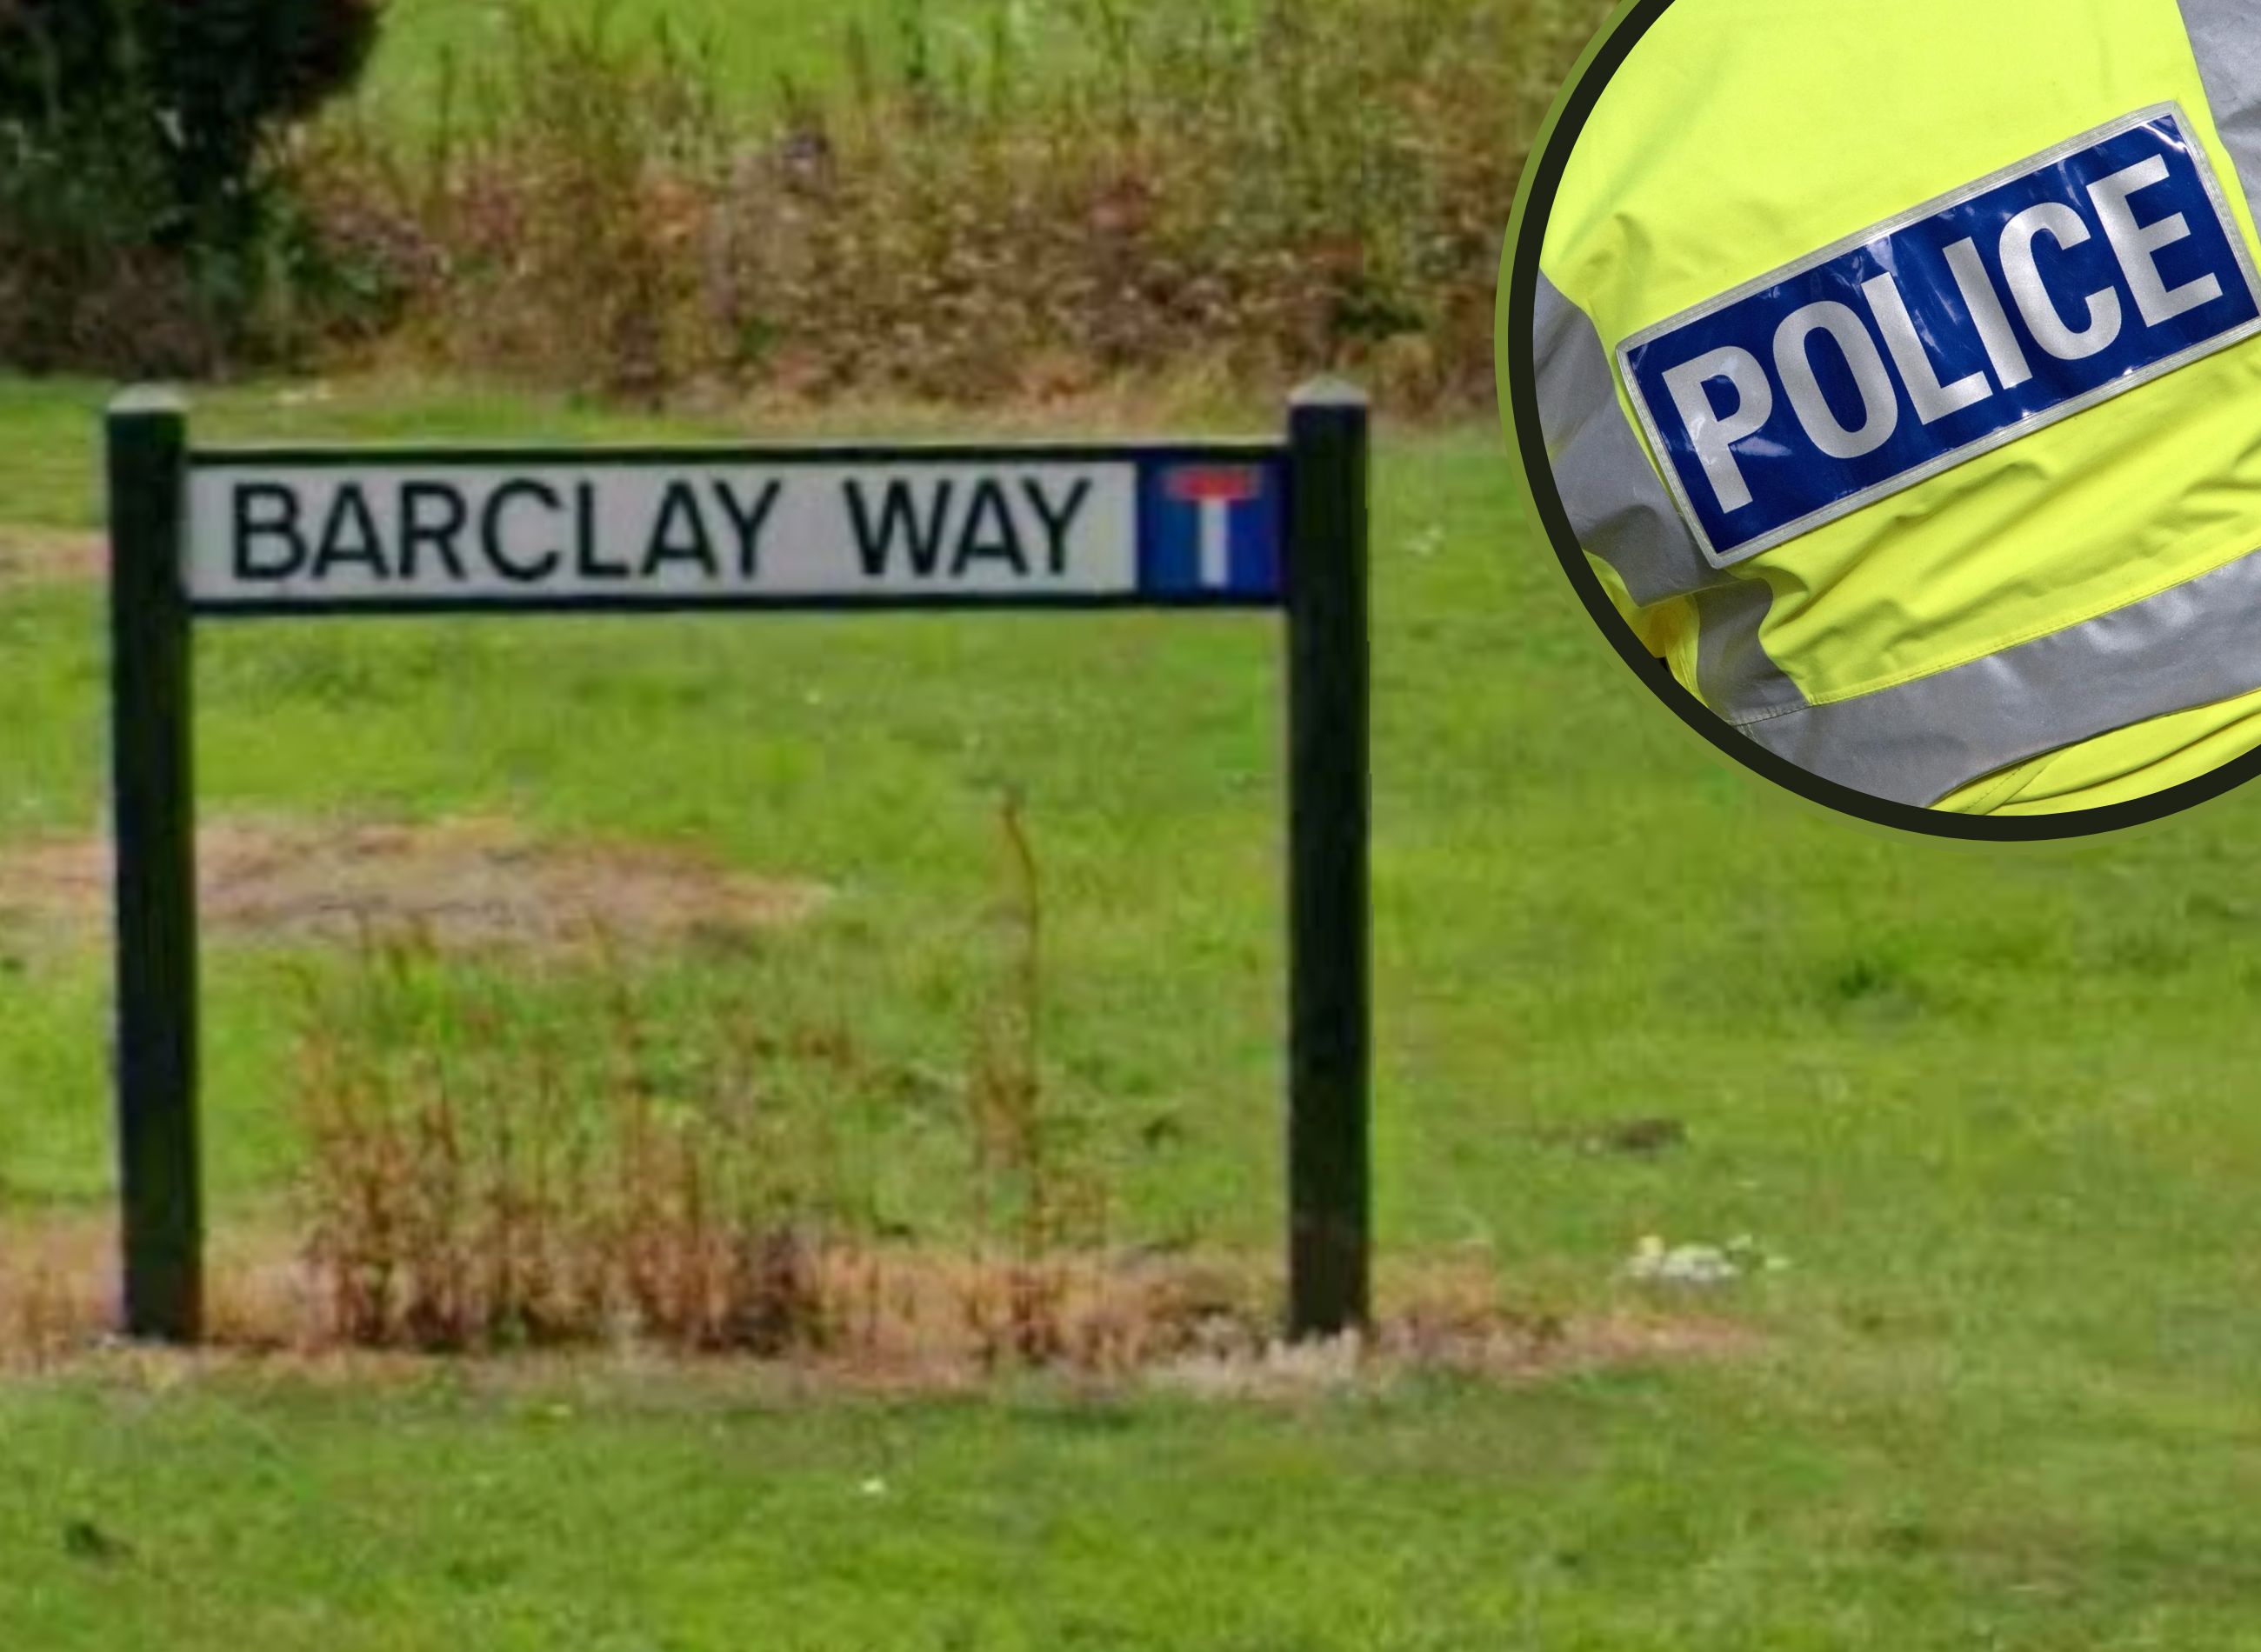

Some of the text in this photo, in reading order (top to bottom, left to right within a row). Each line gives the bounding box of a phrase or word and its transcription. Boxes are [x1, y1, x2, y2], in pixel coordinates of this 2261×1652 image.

[1662, 154, 2222, 514] POLICE
[230, 477, 1092, 582] BARCLAY WAY
